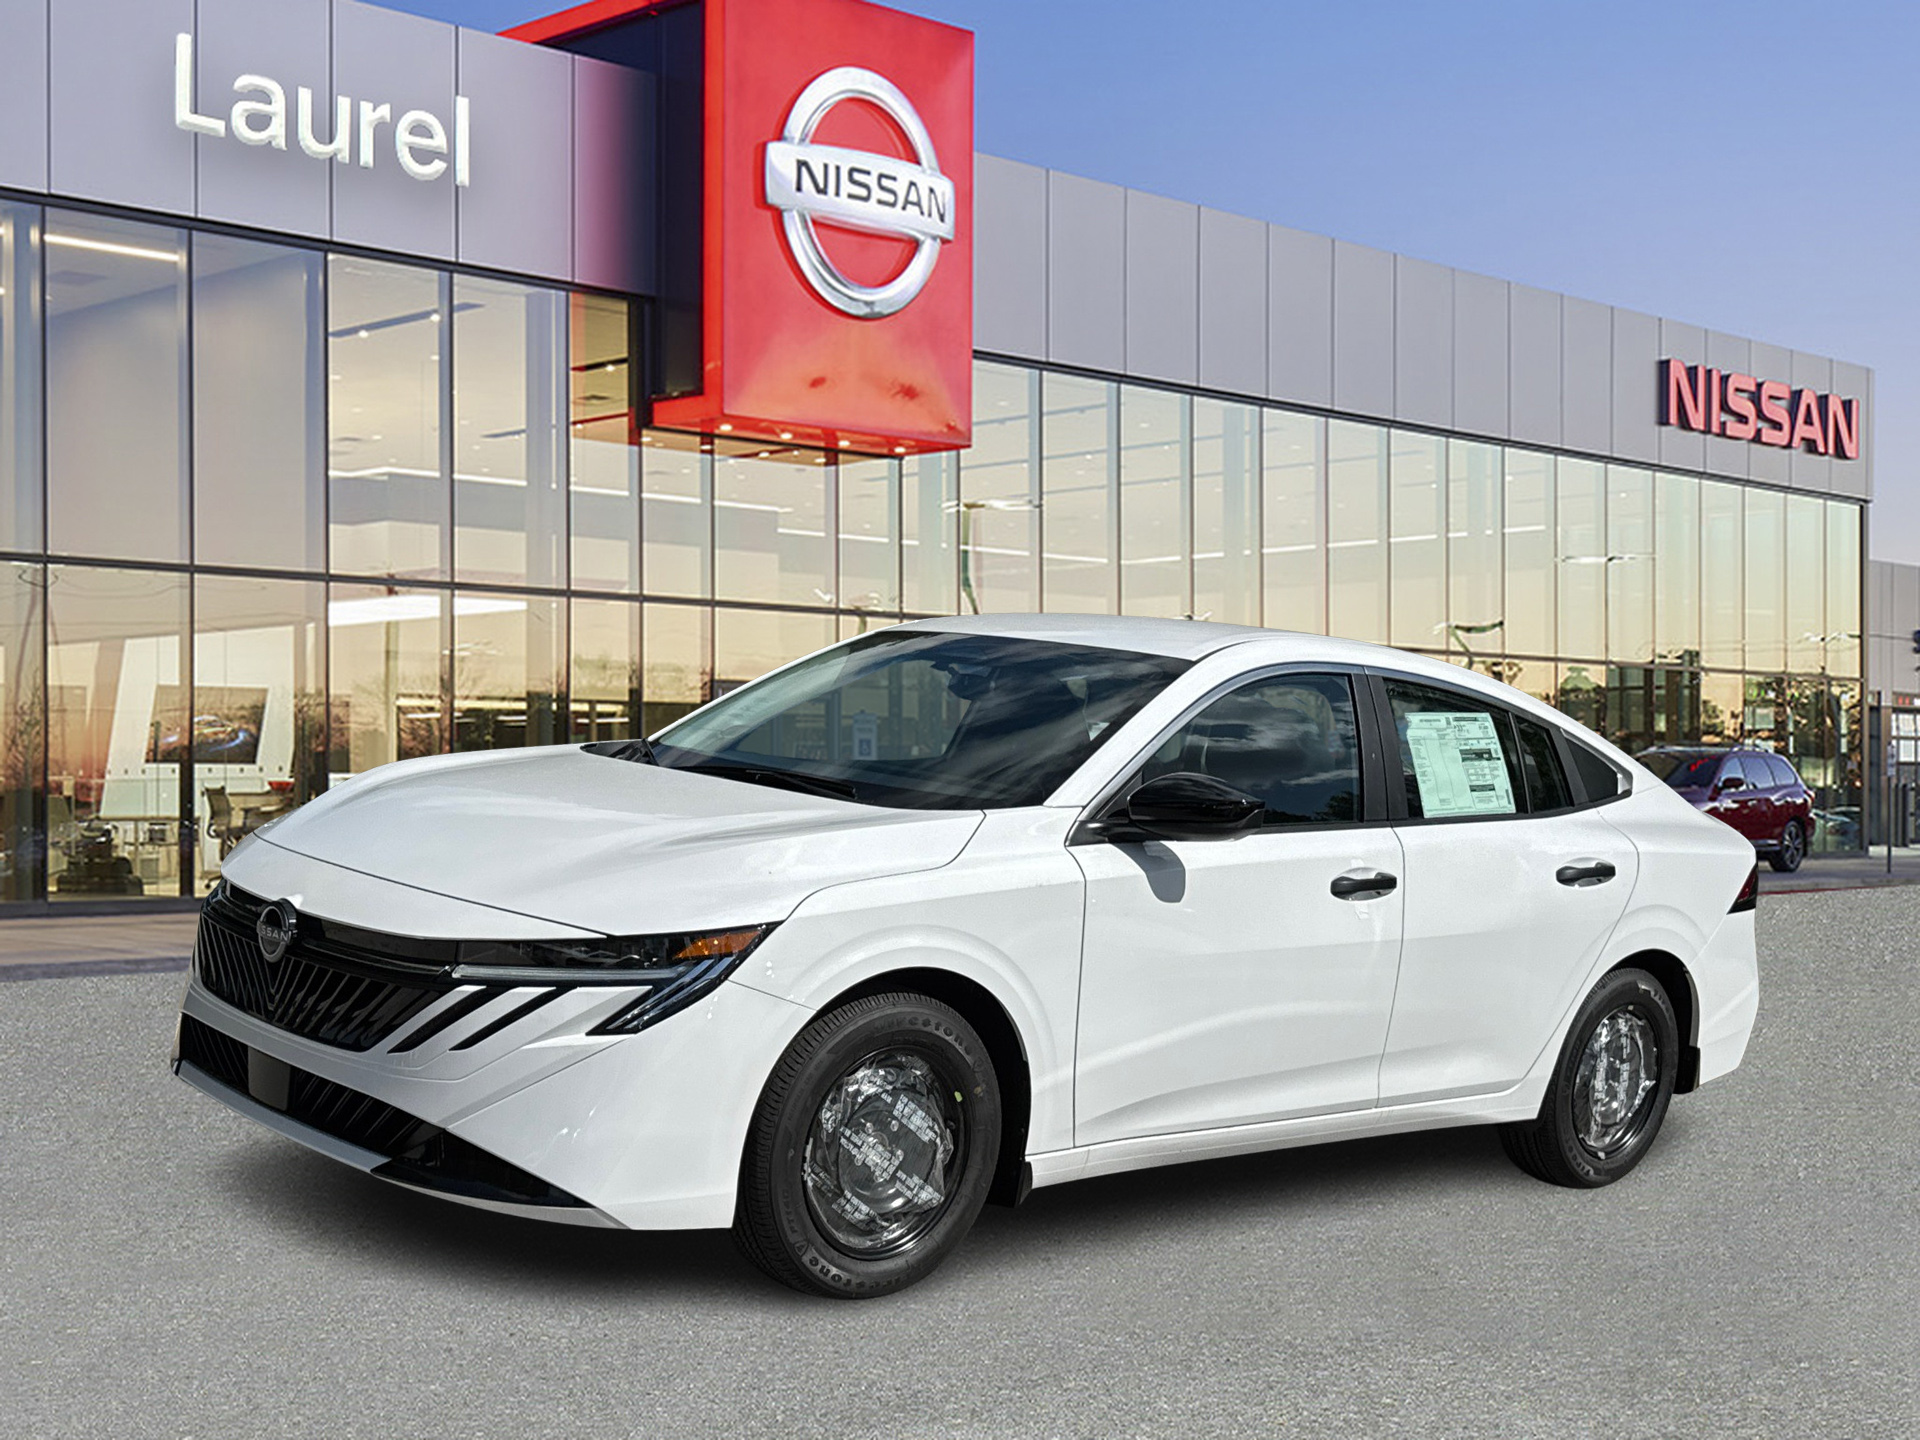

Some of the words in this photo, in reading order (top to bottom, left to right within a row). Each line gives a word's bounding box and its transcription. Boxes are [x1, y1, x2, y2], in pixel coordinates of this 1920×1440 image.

[175, 32, 470, 188] Laurel
[795, 158, 947, 224] NISSAN
[1658, 357, 1860, 460] NISSAN
[260, 925, 288, 942] SSAN
